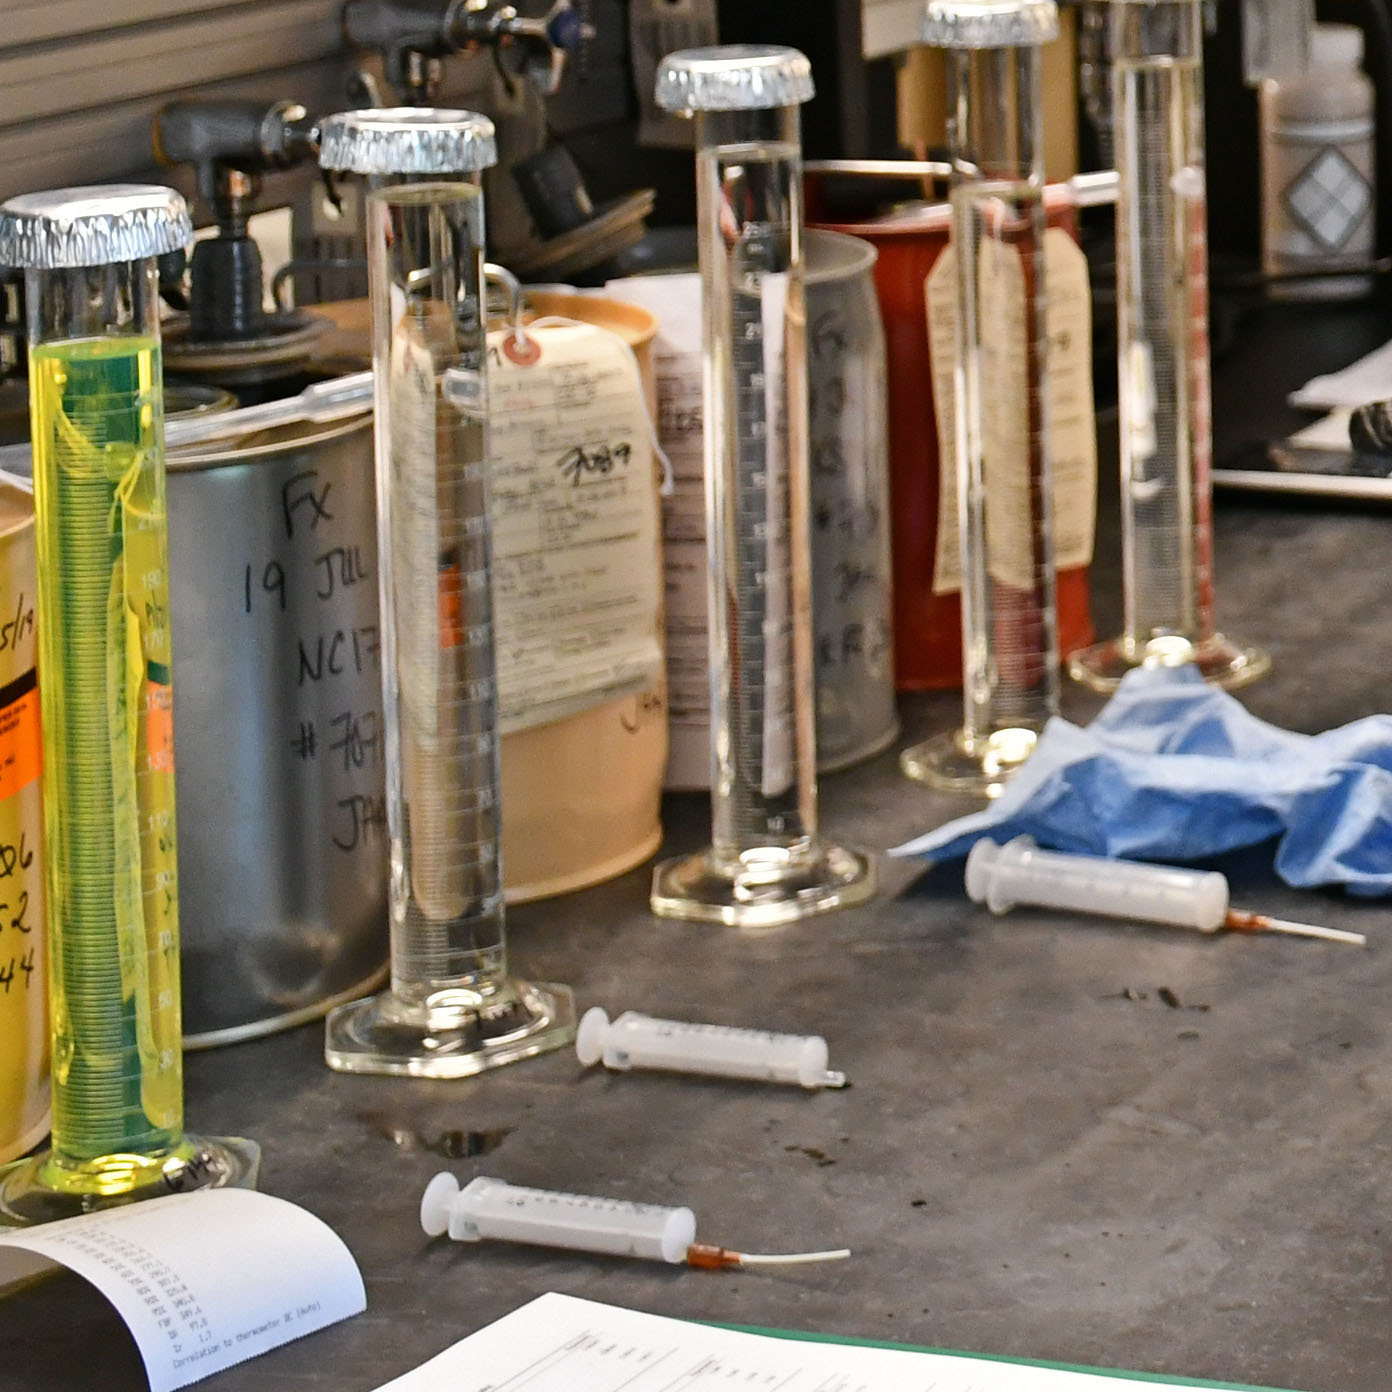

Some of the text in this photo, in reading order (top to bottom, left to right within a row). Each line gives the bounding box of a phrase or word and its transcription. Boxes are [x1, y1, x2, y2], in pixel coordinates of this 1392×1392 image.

[244, 558, 287, 615] 19
[172, 1343, 221, 1369] Correlation
[223, 1338, 234, 1349] to
